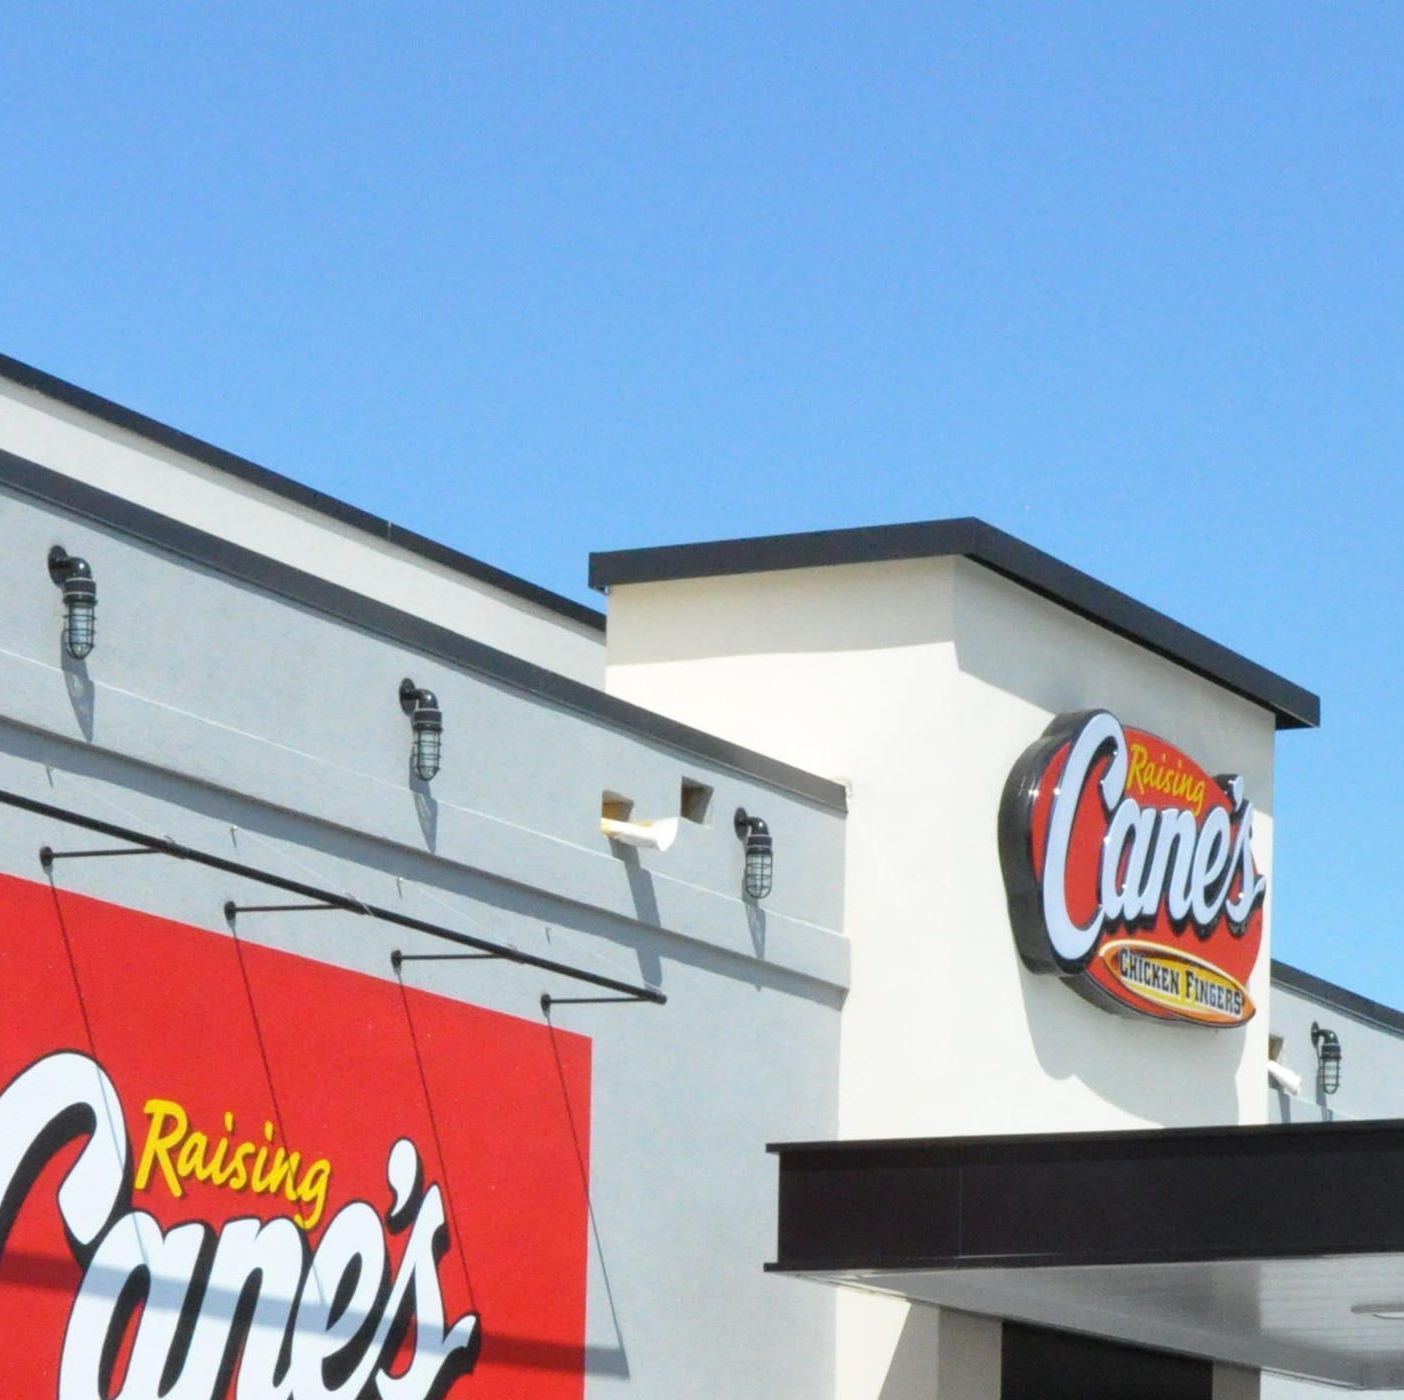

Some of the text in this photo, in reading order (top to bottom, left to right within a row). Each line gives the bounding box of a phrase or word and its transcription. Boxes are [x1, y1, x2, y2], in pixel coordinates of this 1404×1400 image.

[1125, 743, 1207, 817] Raising
[1044, 710, 1266, 961] Cane's
[1119, 948, 1243, 1016] CHICKEN FINGERS
[134, 1098, 332, 1229] Raising
